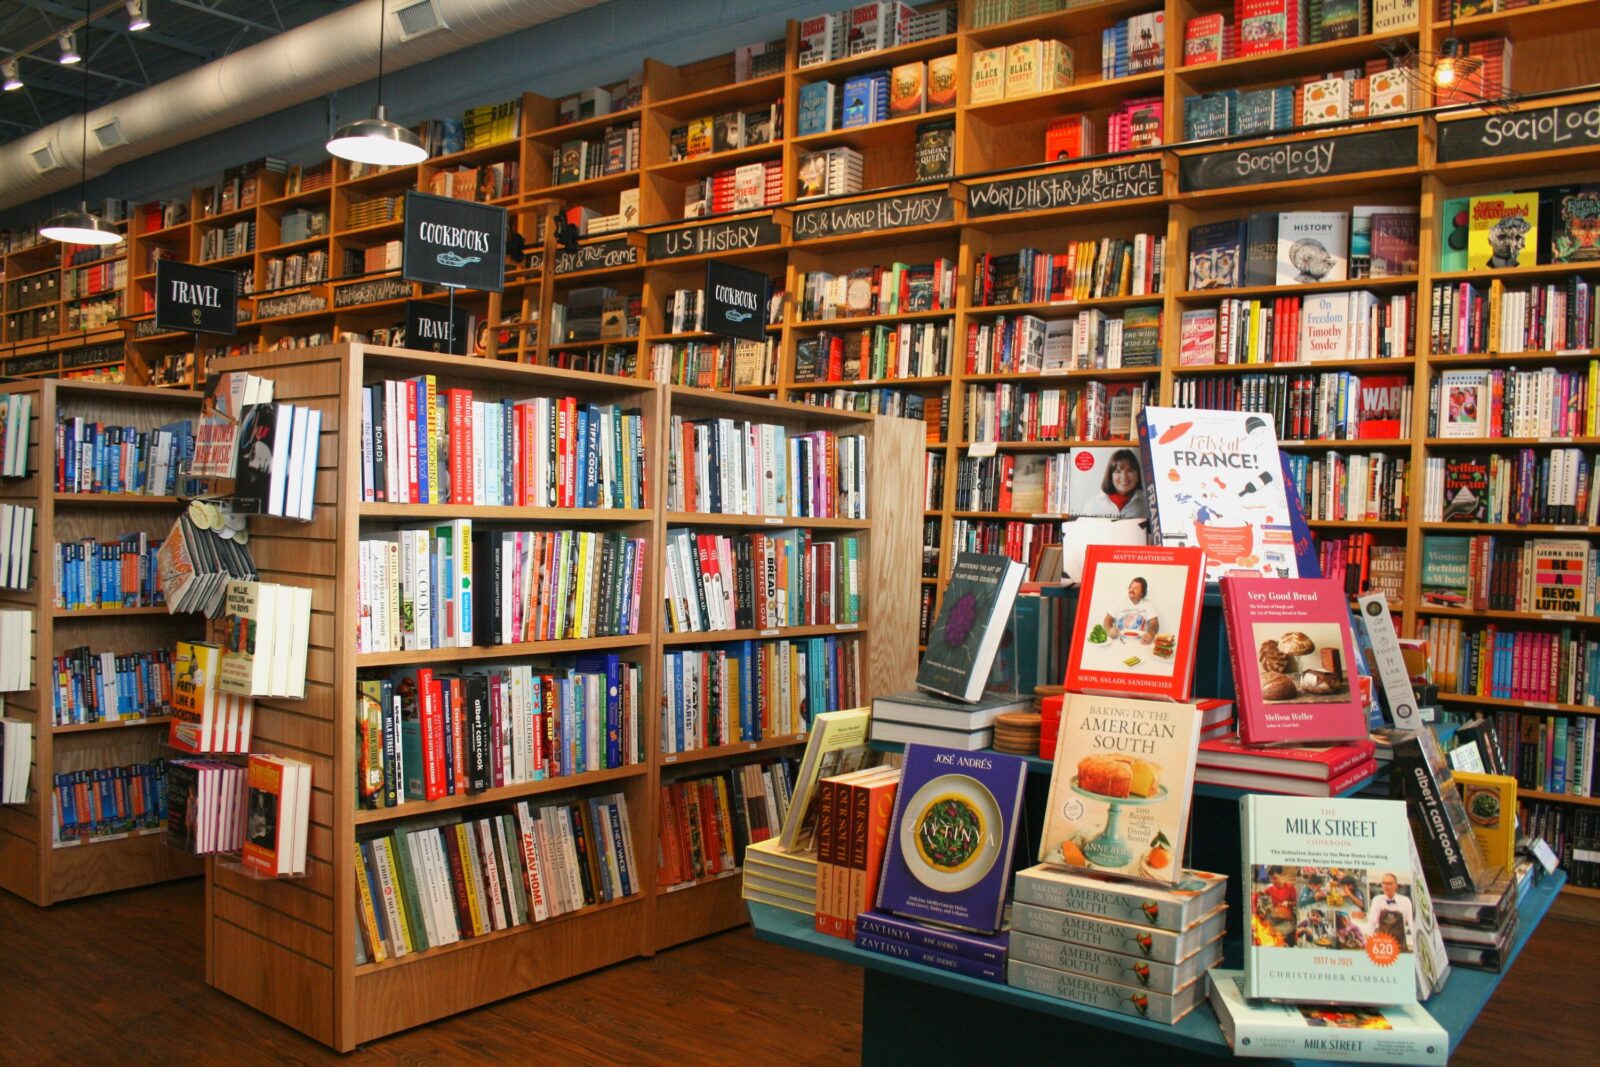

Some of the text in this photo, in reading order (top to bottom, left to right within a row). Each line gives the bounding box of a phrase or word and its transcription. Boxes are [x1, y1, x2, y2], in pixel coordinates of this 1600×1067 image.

[1376, 12, 1416, 29] canto
[976, 69, 998, 80] BLACK
[1010, 63, 1032, 74] BLACK
[1146, 122, 1159, 130] AND
[1132, 132, 1156, 142] PRIMAS
[920, 153, 946, 165] QUEEN
[736, 186, 758, 197] SIEGE
[970, 184, 1027, 211] WORLD
[832, 210, 876, 230] WORLD
[1294, 224, 1333, 232] HISTORY
[420, 221, 490, 253] COOKBOOKS
[667, 232, 693, 254] U.S.
[576, 252, 584, 268] &
[171, 280, 222, 308] TRAVEL
[715, 284, 758, 310] COOKBOOKS
[1319, 299, 1332, 310] On
[1308, 311, 1343, 323] Freedom
[1308, 326, 1342, 342] Timothy
[1310, 339, 1337, 352] Snyder
[1363, 388, 1401, 410] WAR
[375, 426, 383, 463] BOARDS
[428, 383, 437, 489] BRIGHT COOKING
[1174, 451, 1258, 469] FRANCE!
[588, 450, 596, 488] COOKS
[1448, 464, 1486, 474] Selling
[1137, 555, 1174, 563] MATHESON
[1552, 560, 1568, 570] BE
[1556, 574, 1564, 584] A
[1248, 592, 1318, 602] Very Good Bread
[1542, 588, 1575, 599] REVO
[1536, 600, 1580, 612] LUTION
[1078, 675, 1172, 689] SOUPS, SALADS, SANDWICHES
[1090, 705, 1170, 722] BAKING IN THE
[1265, 713, 1313, 721] Melissa Weller
[1080, 717, 1176, 739] AMERICAN
[386, 737, 394, 756] STREET
[1093, 735, 1155, 754] SOUTH
[476, 747, 484, 771] cook
[934, 753, 992, 770] JOSÉ ANDRÉS
[823, 786, 832, 815] OUR
[1130, 812, 1154, 822] Recipes
[1414, 767, 1438, 808] albert
[1440, 833, 1459, 865] cook
[837, 790, 848, 862] OUR SOUTH
[854, 792, 866, 864] OUR SOUTH
[1286, 818, 1377, 838] MILK STREET
[822, 816, 832, 858] SOUTH
[524, 833, 543, 907] ZAHAV HOME
[1067, 888, 1131, 908] AMERICAN
[1065, 899, 1107, 915] SOUTH
[1061, 928, 1102, 945] SOUTH
[1064, 918, 1125, 938] AMERICAN
[1059, 946, 1122, 969] AMERICAN
[1372, 942, 1393, 956] 620
[1058, 955, 1100, 975] SOUTH
[1313, 956, 1353, 967] 2017 to 2025
[1269, 970, 1399, 985] CHRISTOPHER KIMBALL
[1057, 985, 1098, 1005] SOUTH
[1058, 975, 1120, 999] AMERICAN
[1304, 1039, 1327, 1050] MILK
[1329, 1040, 1363, 1051] STREET
